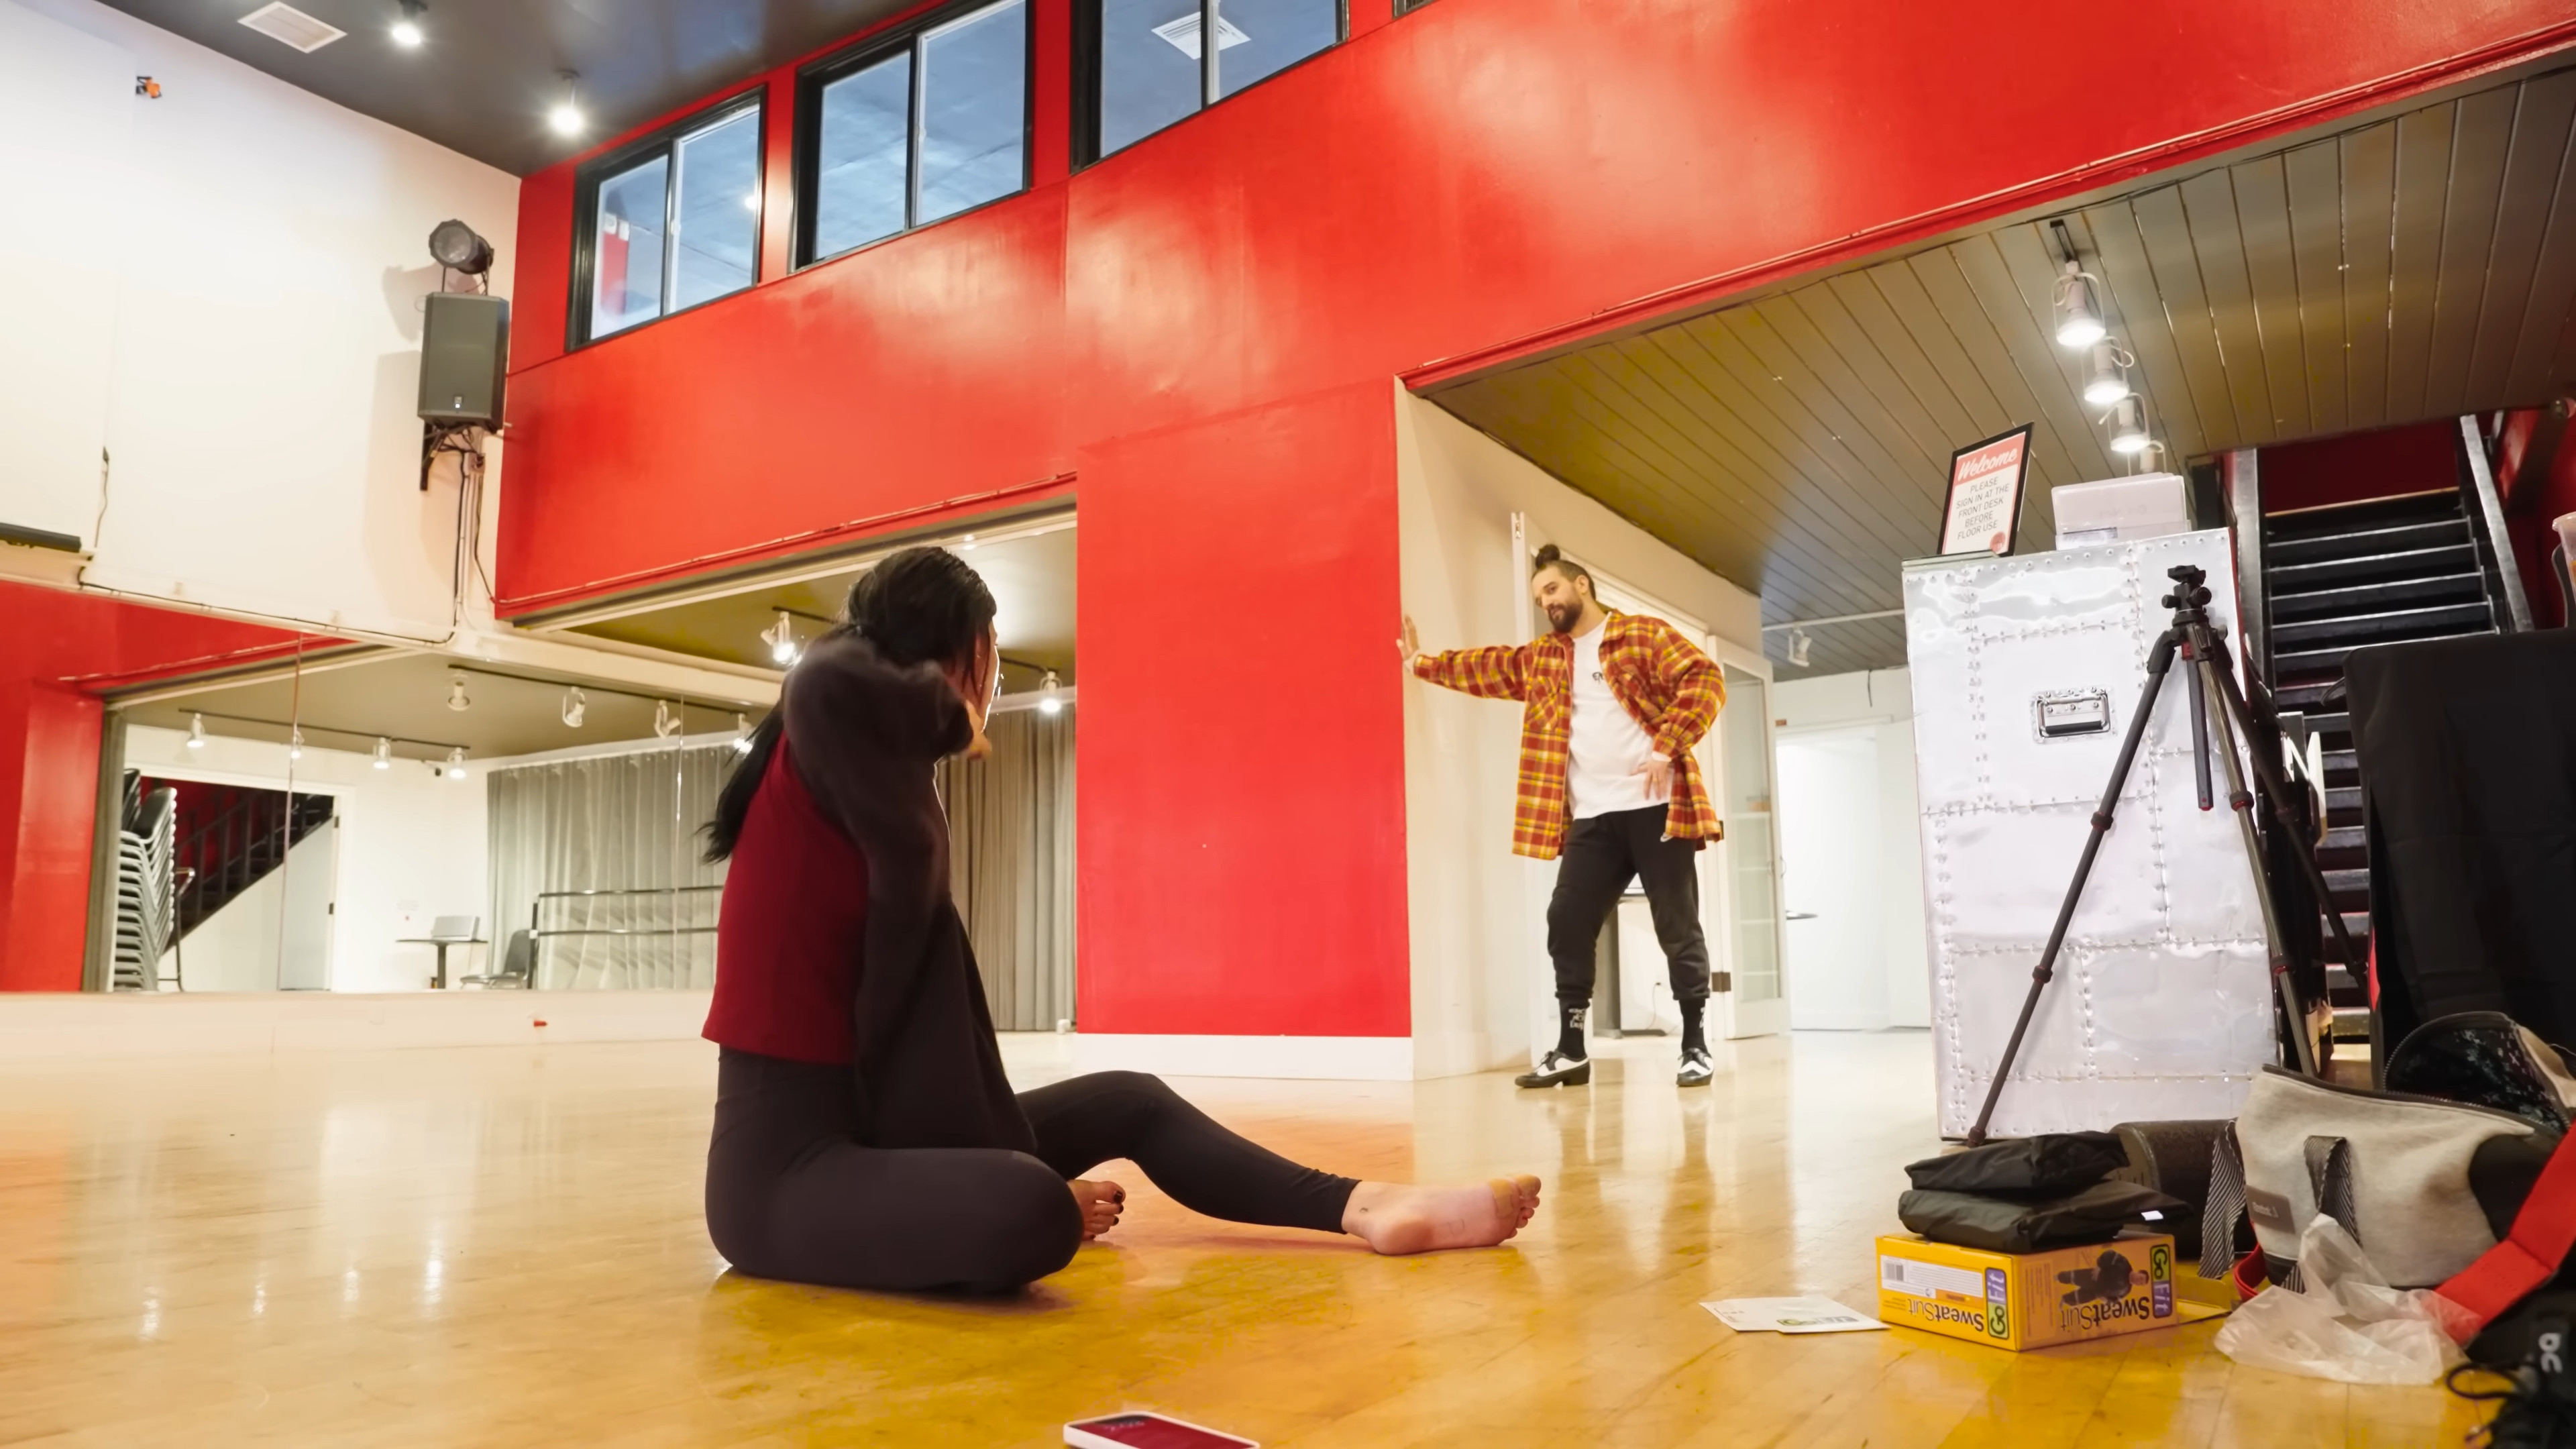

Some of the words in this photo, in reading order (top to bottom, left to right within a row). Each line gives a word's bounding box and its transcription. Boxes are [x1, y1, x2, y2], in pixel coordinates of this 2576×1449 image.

[1957, 449, 2017, 480] Welcome
[1971, 477, 1998, 492] PLEASE
[1957, 497, 1973, 509] SIGN
[1976, 493, 1982, 502] IN
[1985, 490, 1993, 498] AT
[1996, 484, 2009, 494] THE
[1959, 504, 1981, 518] FRONT
[1984, 497, 2004, 510] DESK
[1958, 526, 1981, 539] FLOOR
[1984, 520, 1998, 531] USE
[1966, 511, 1993, 527] BEFORE
[1907, 1299, 1984, 1332] SweatSuit
[2061, 1297, 2149, 1333] SweatSuit
